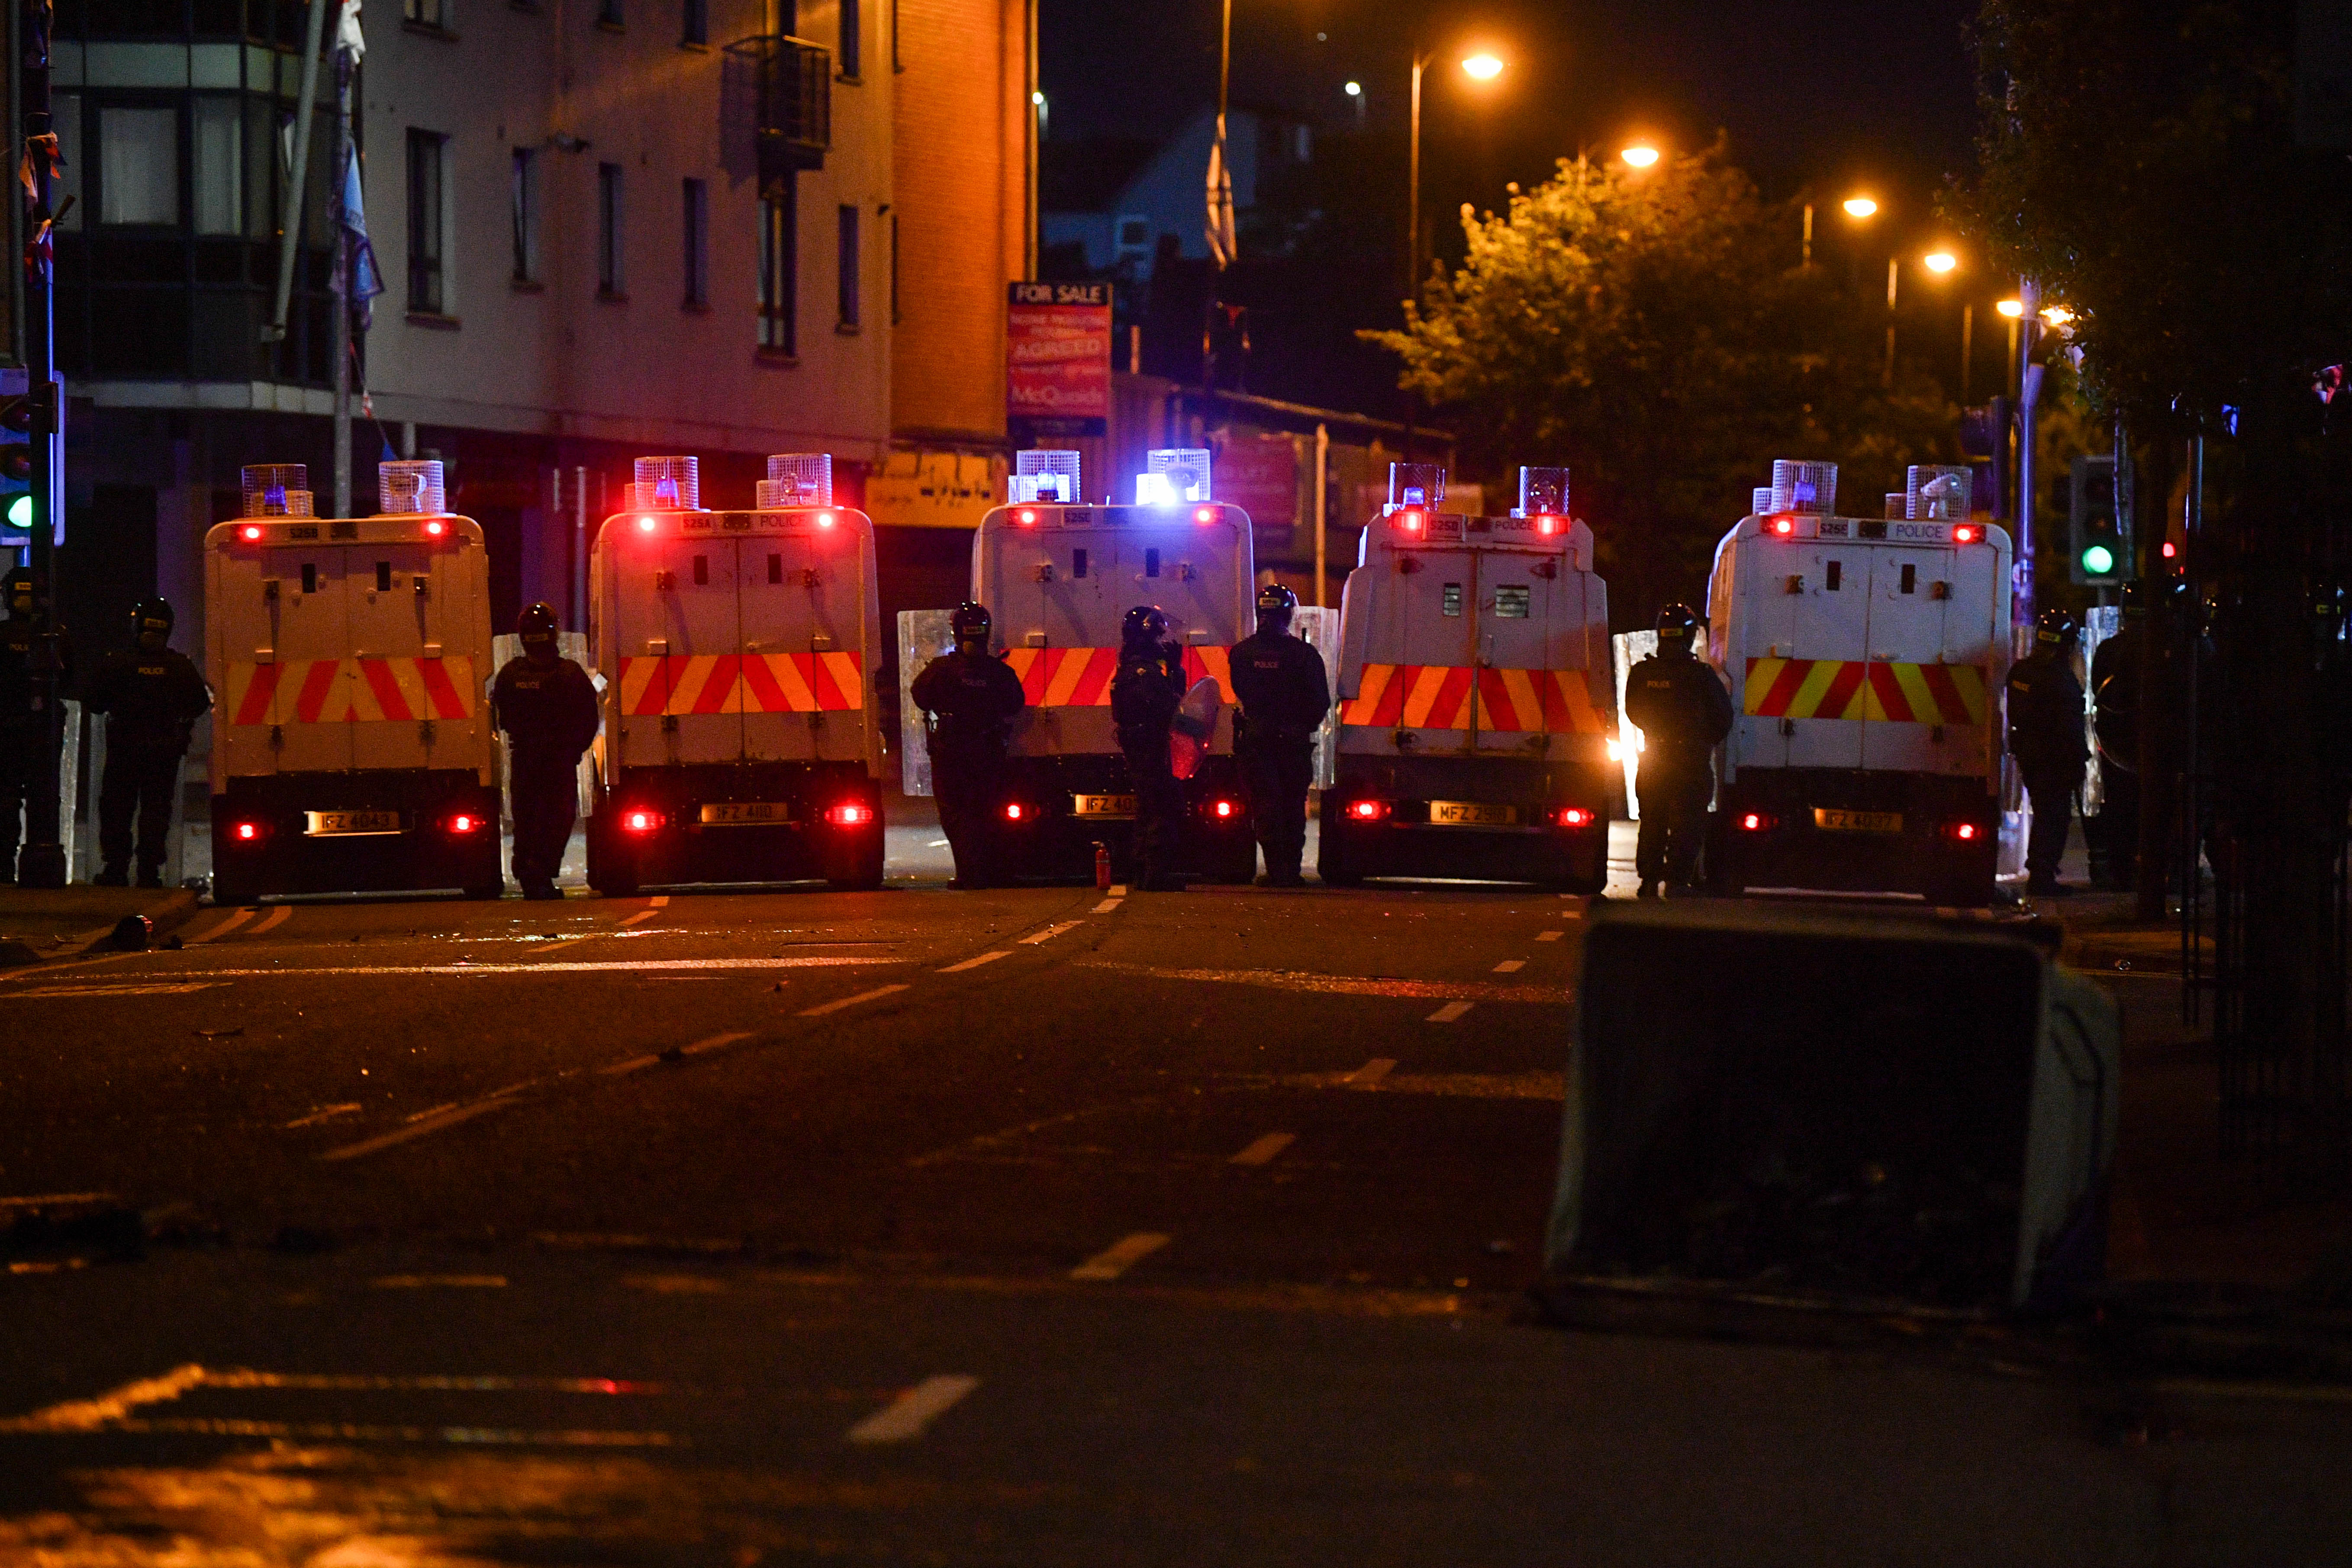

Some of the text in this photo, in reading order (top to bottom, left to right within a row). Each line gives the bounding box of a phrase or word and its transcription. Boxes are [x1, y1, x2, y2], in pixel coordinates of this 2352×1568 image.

[1017, 285, 1101, 303] FOR SALE
[760, 515, 805, 527] POLICE
[1495, 521, 1534, 531] POLICE
[1896, 524, 1943, 538] POLICE
[138, 667, 164, 675] POLICE
[1254, 660, 1280, 669] POLICE
[1086, 798, 1109, 811] IFZ
[1440, 806, 1469, 820] MFZ
[322, 815, 346, 828] IFZ
